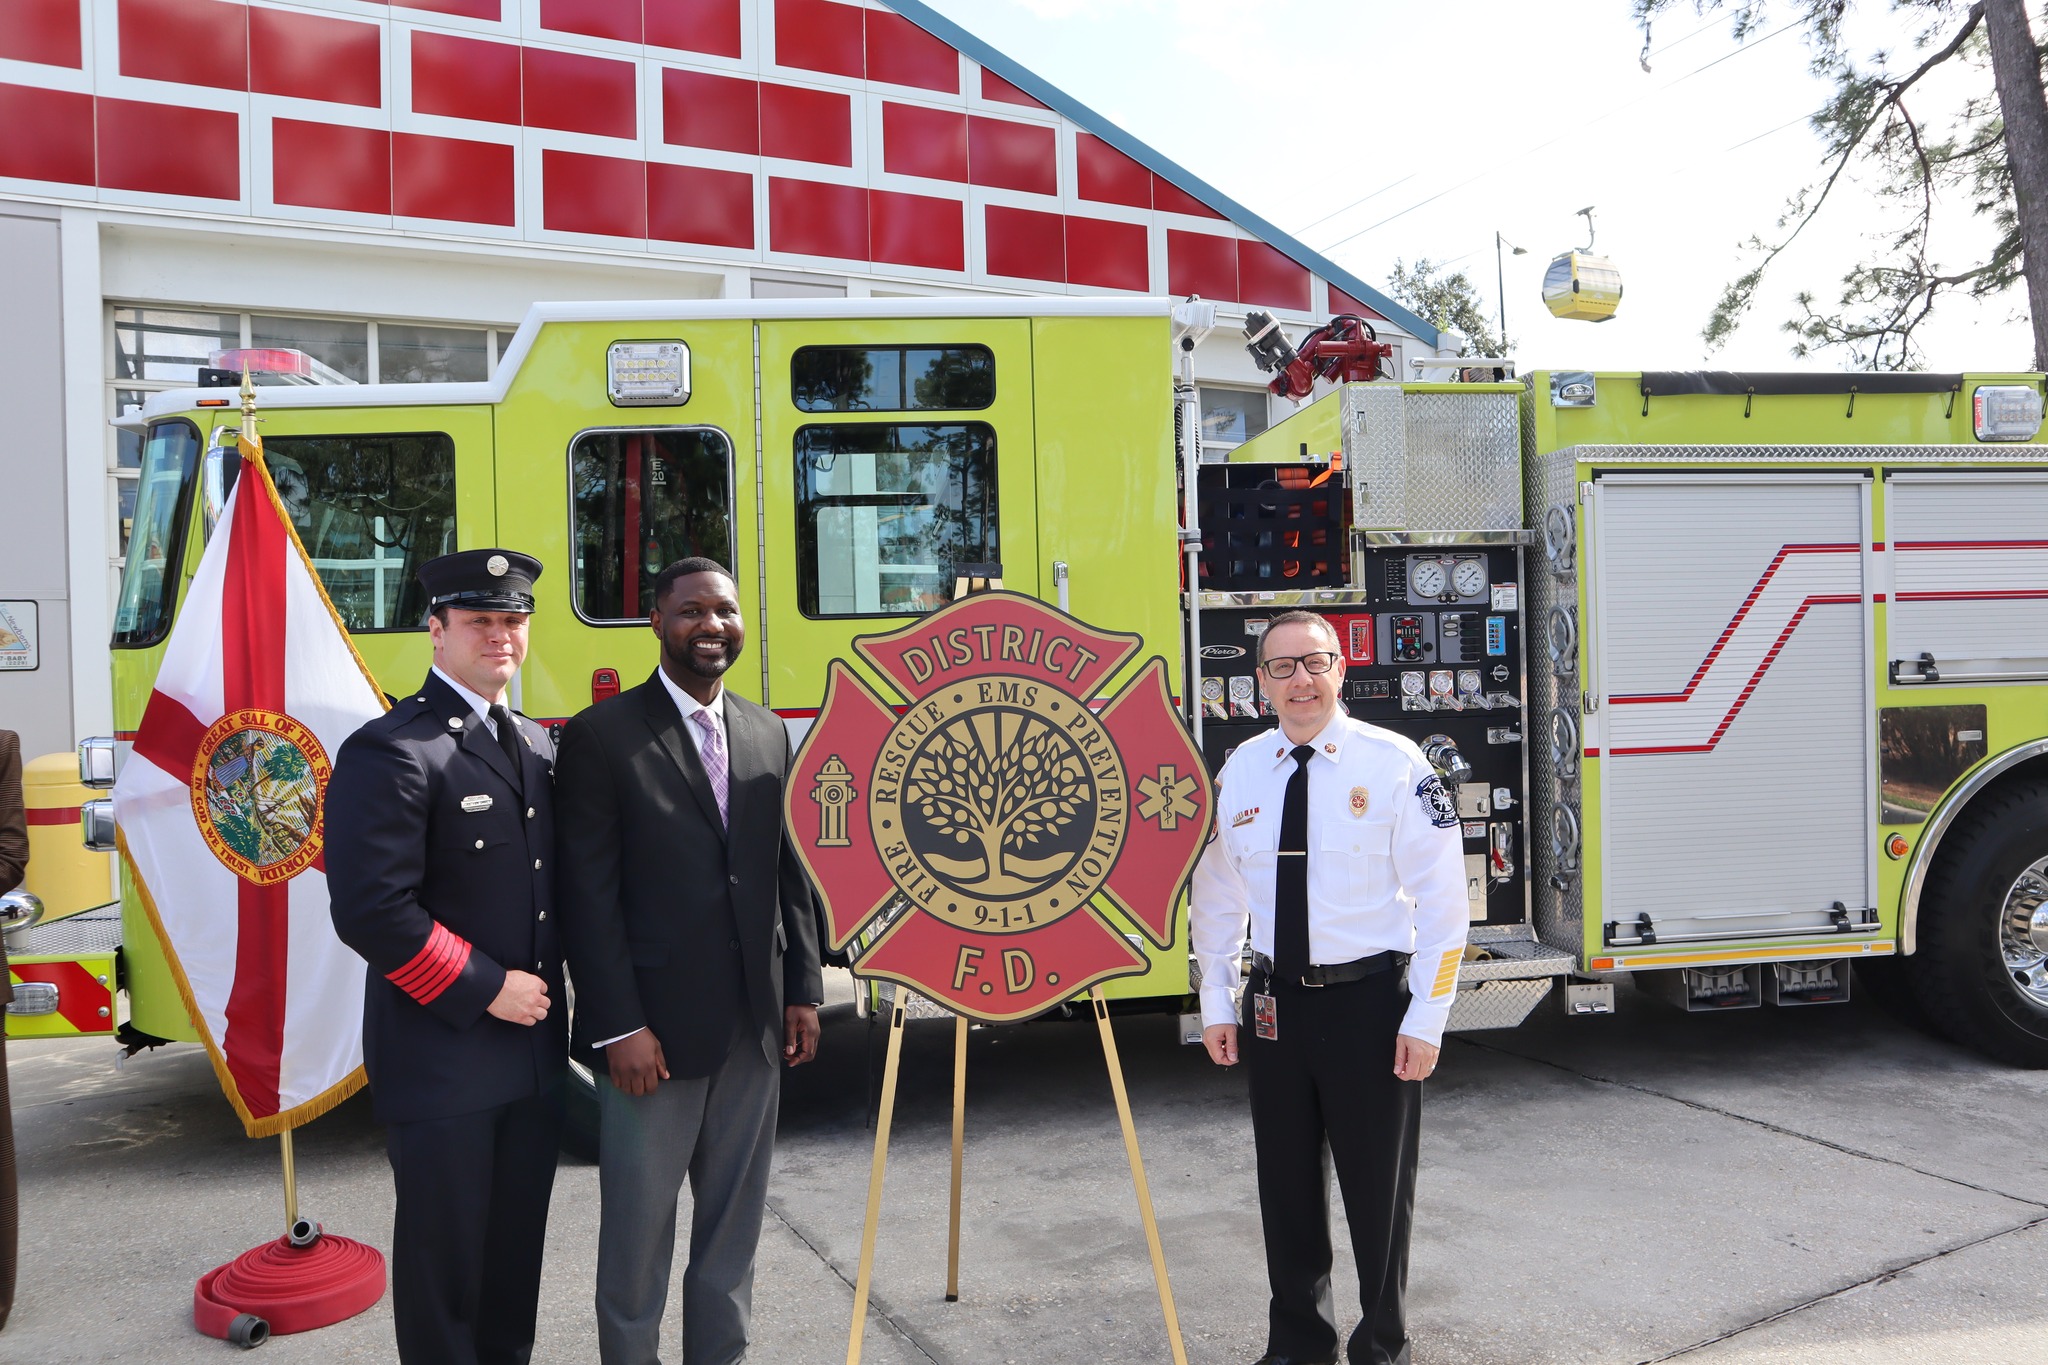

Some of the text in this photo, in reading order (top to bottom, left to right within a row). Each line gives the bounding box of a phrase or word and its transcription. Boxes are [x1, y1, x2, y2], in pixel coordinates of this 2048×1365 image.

[651, 471, 665, 481] 20
[652, 461, 662, 471] E
[900, 624, 1100, 686] DISTRICT
[1202, 646, 1238, 657] Pierce
[240, 712, 270, 727] SEAL
[274, 718, 297, 735] OF
[201, 718, 234, 757] GREAT
[299, 730, 322, 763] THE
[875, 681, 1122, 905] FIRE RESCUE EMS PREVENTION
[193, 777, 251, 874] IN GOD WE TRUST
[258, 841, 320, 883] FLORIDA
[973, 903, 1037, 928] 9-1-1
[951, 944, 1060, 996] F.D.
